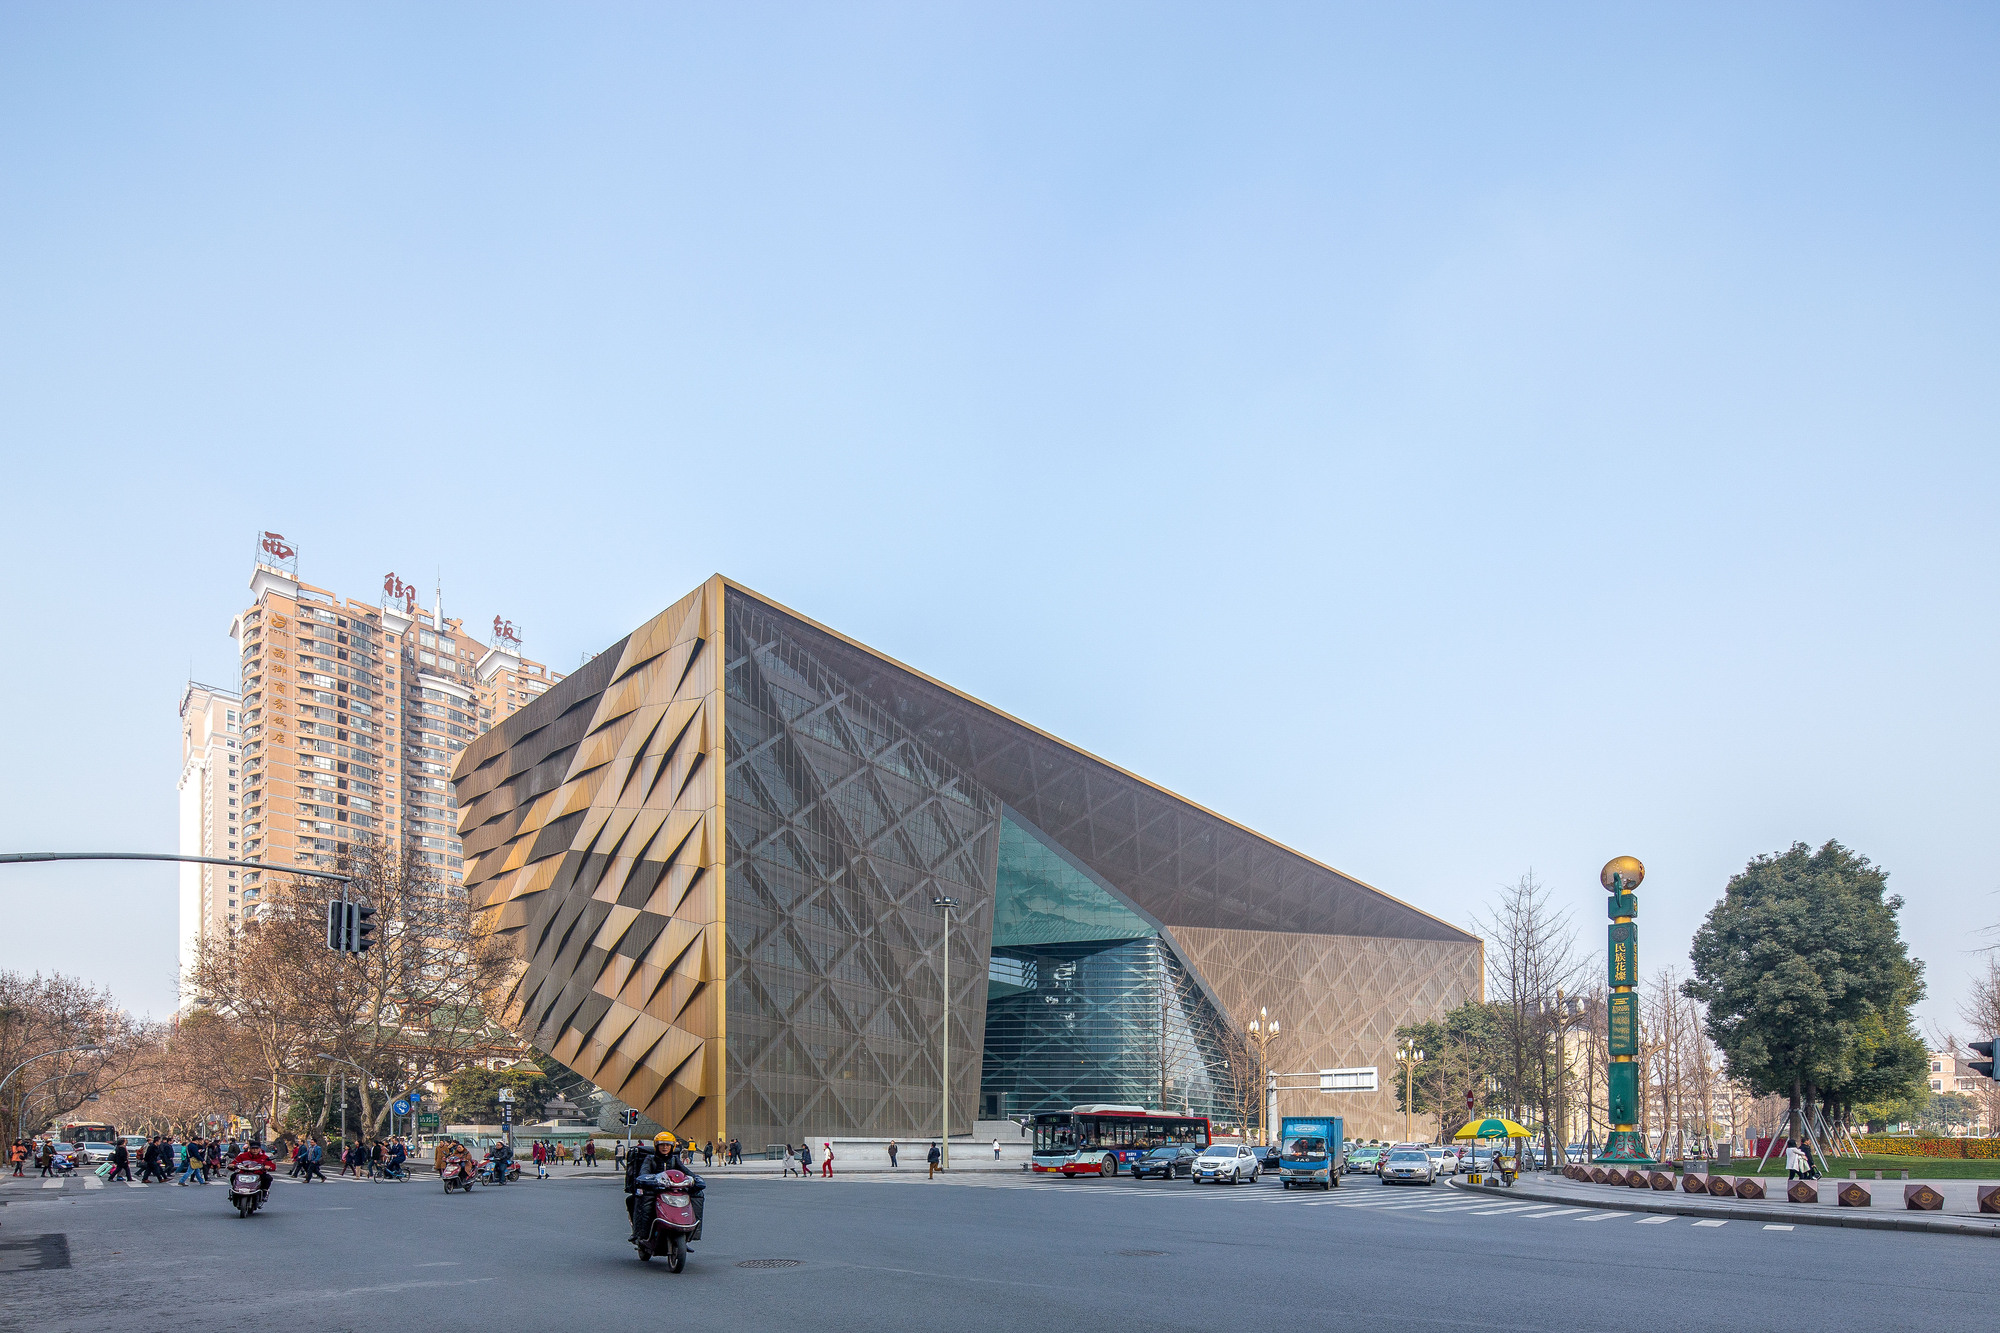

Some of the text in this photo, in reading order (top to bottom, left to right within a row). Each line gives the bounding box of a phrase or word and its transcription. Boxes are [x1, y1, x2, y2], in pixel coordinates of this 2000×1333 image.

[262, 531, 523, 643] 西 御 饭
[268, 628, 289, 638] HOTEL
